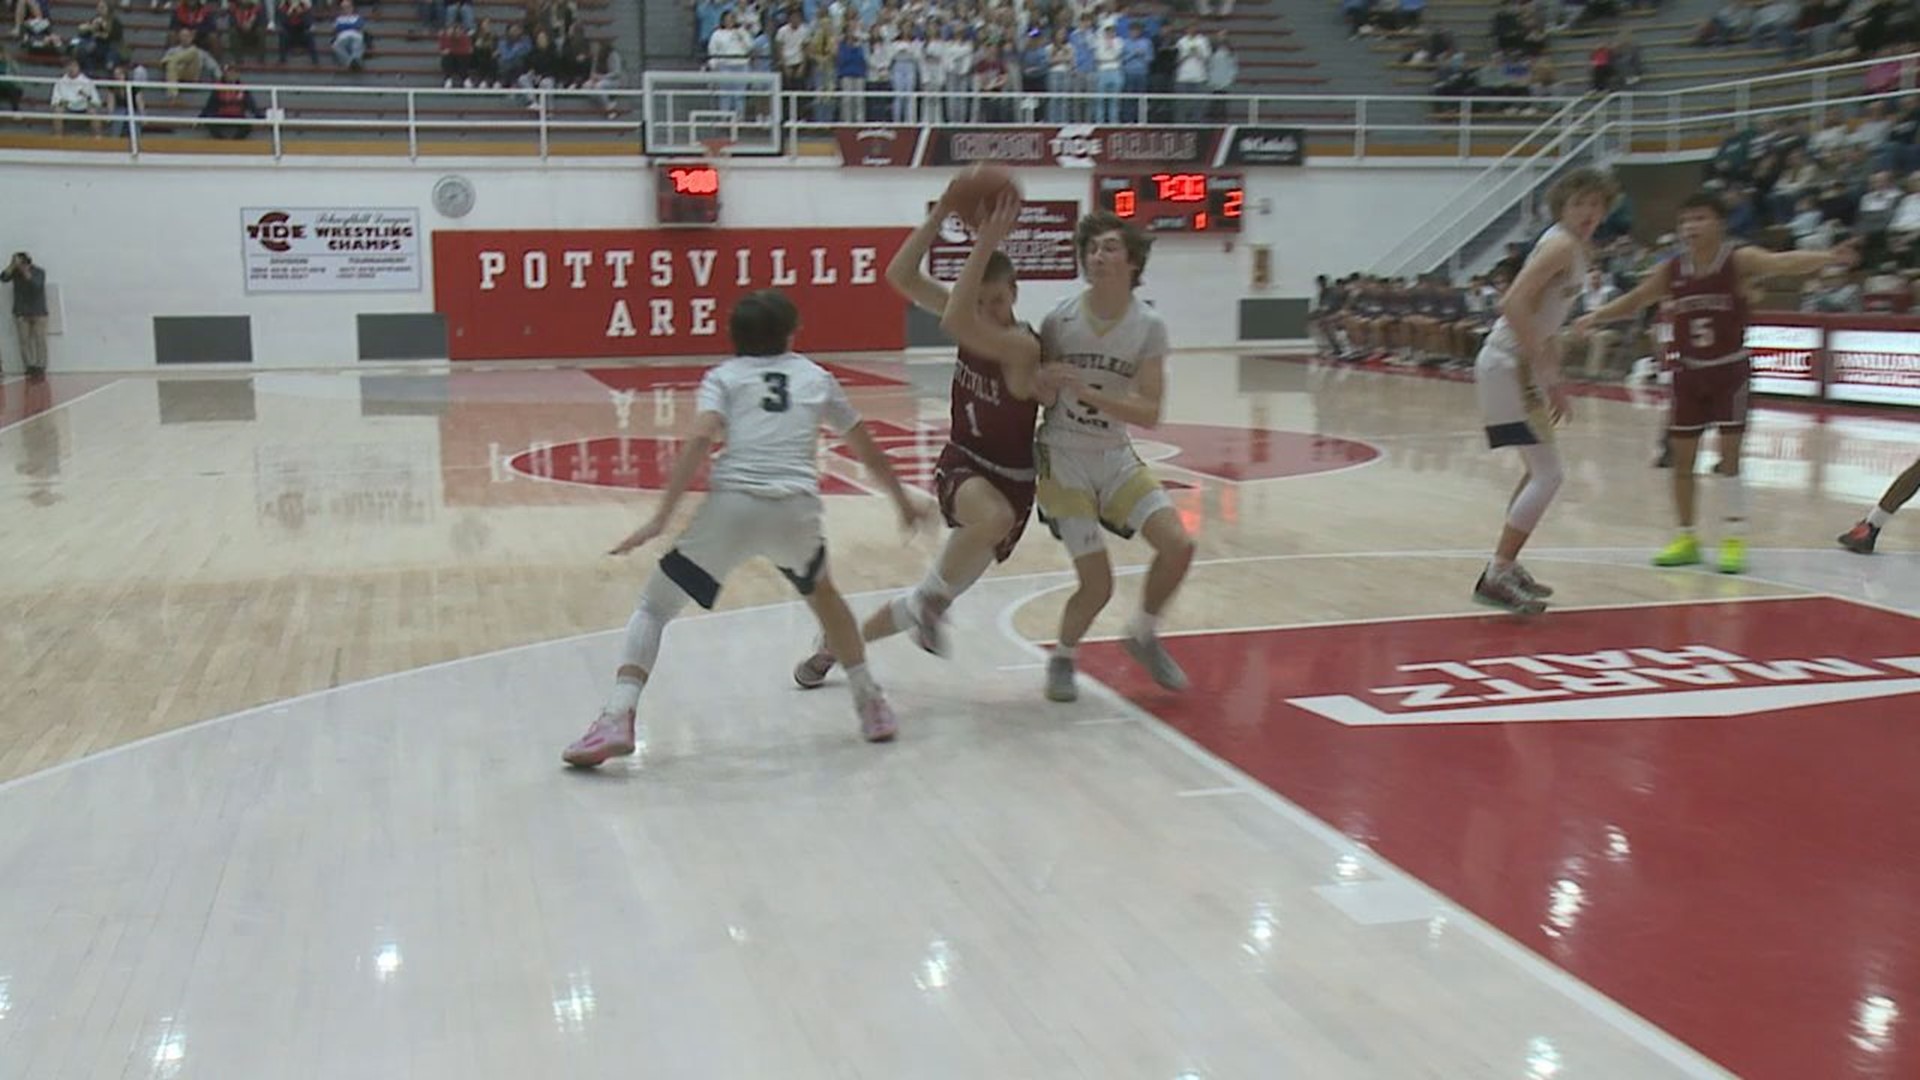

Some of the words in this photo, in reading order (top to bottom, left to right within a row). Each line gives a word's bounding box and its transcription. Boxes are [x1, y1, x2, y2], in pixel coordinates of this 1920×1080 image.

[1048, 137, 1103, 156] TIDE
[1115, 190, 1135, 217] 0
[1223, 190, 1244, 217] 2
[246, 225, 307, 239] TIDE
[314, 226, 414, 238] WRESTLING
[327, 239, 402, 251] CHAMPS
[479, 247, 877, 290] POTTSVILLE
[606, 298, 718, 337] ARE
[1688, 317, 1715, 348] 5
[761, 372, 789, 413] 3
[964, 401, 982, 438] 1
[1396, 645, 1751, 679] HALL
[1369, 657, 1886, 708] MARTZ
